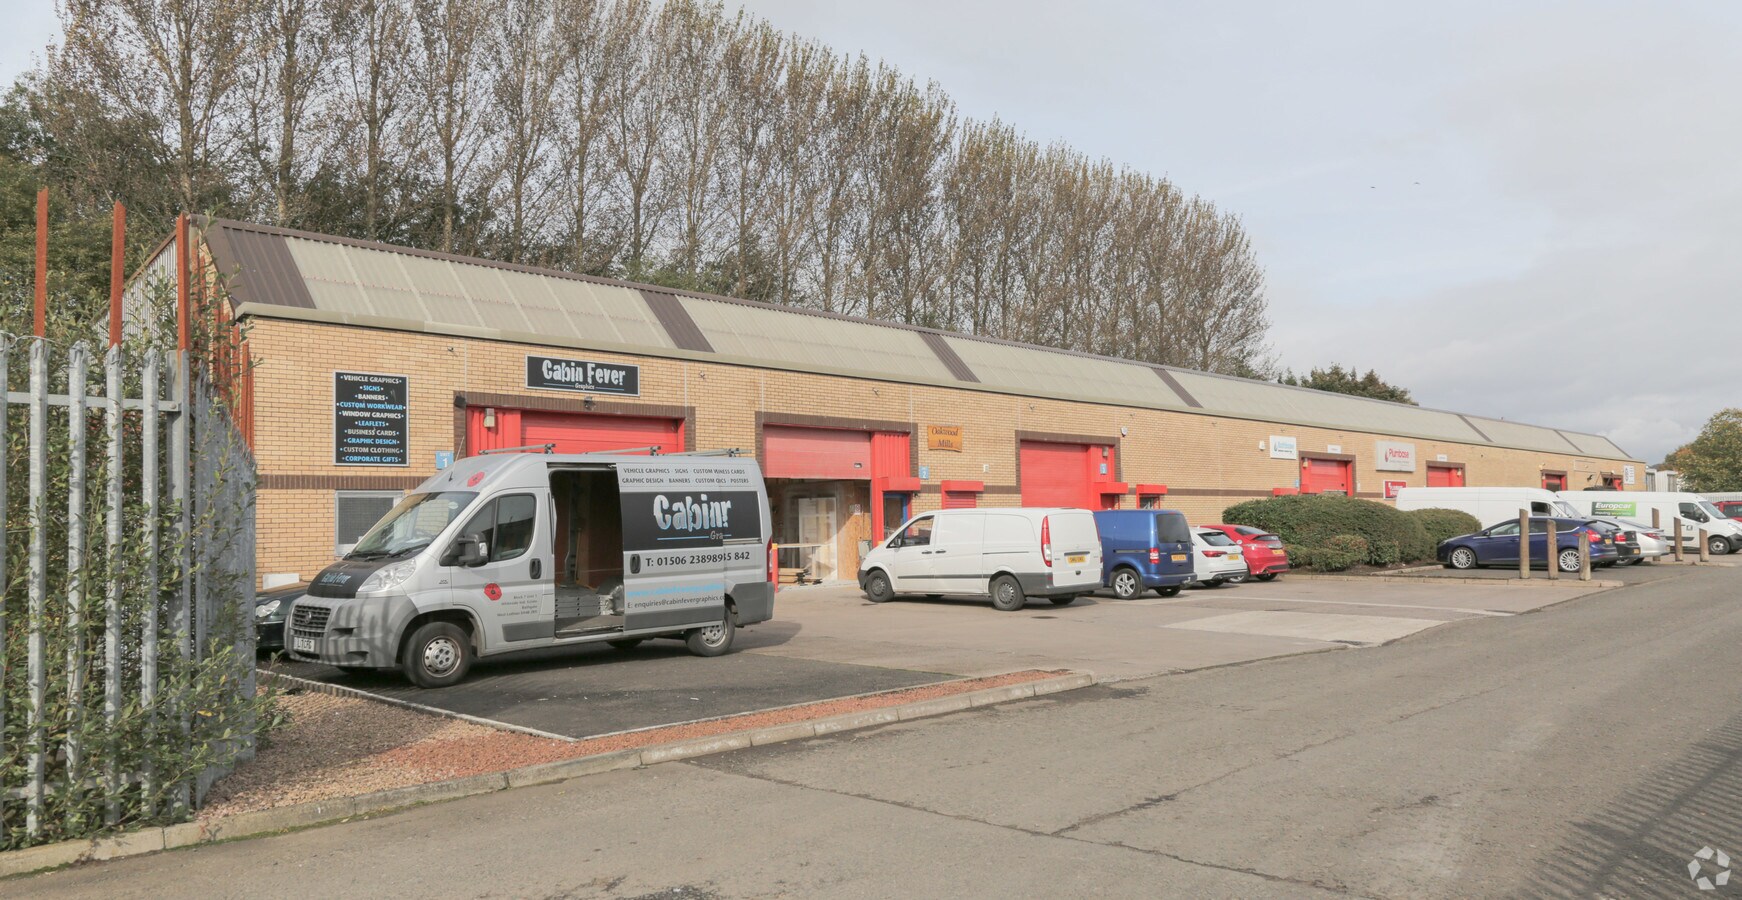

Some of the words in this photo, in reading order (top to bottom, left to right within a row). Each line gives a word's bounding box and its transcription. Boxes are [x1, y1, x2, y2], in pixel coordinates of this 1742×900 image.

[542, 360, 583, 382] Cabin
[586, 363, 626, 385] Fever
[932, 427, 958, 436] Oakwood
[938, 439, 953, 448] Mills
[1389, 448, 1409, 458] Plumbase
[442, 458, 447, 468] 1
[645, 558, 654, 567] T:
[657, 556, 687, 566] 01506
[734, 552, 750, 560] 842
